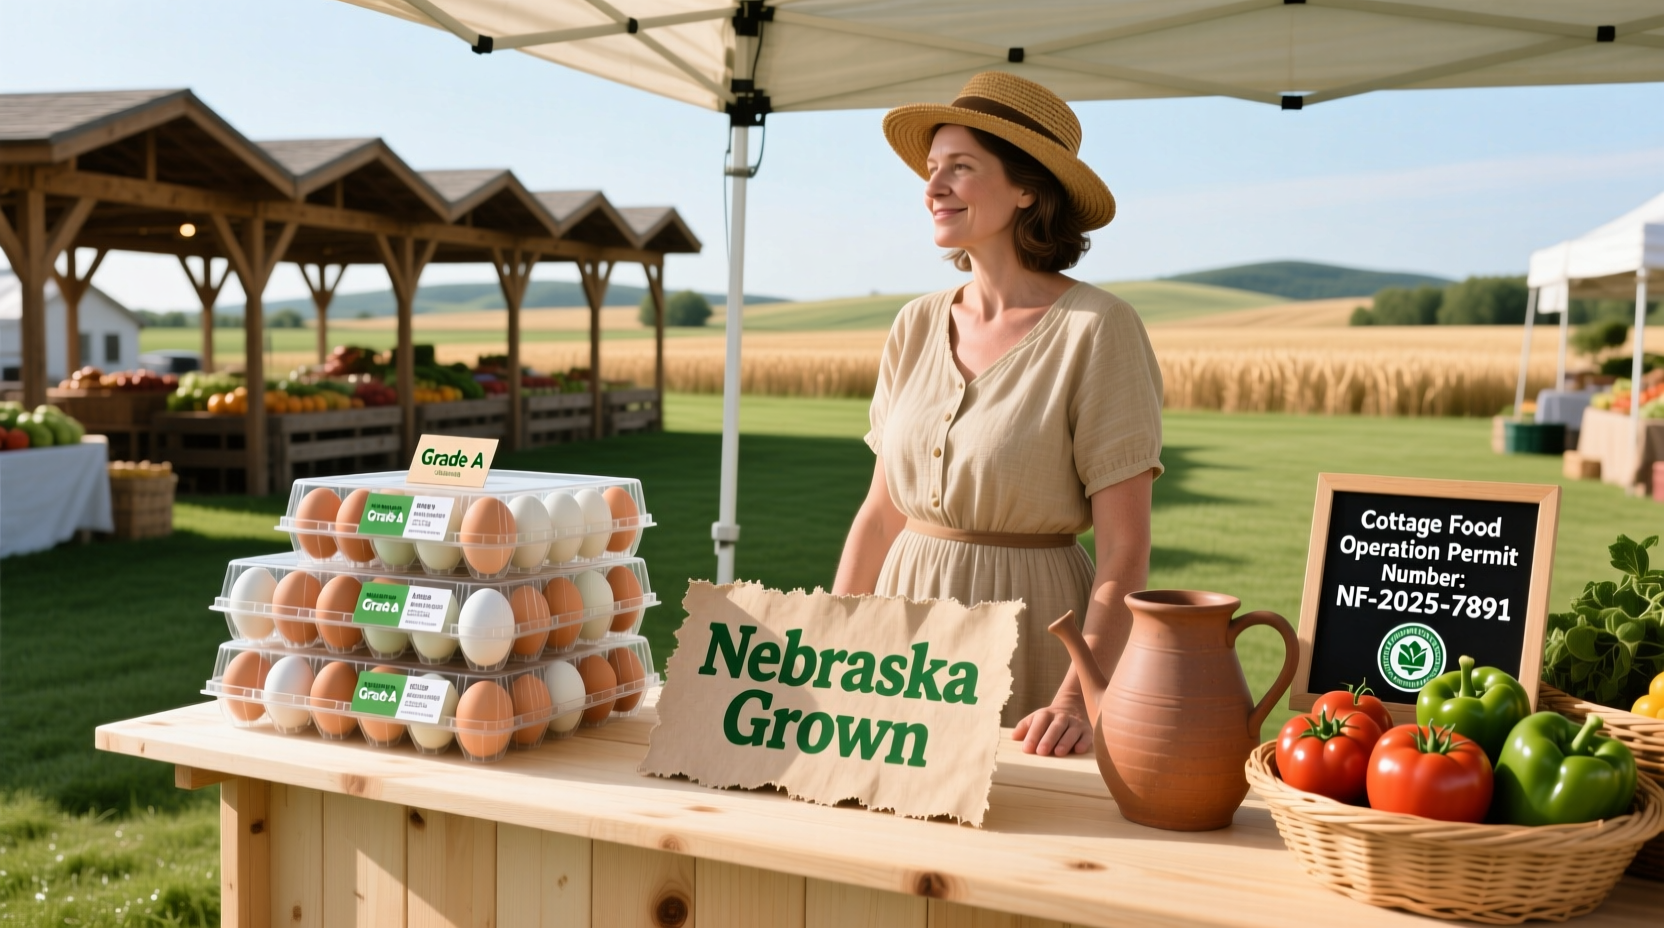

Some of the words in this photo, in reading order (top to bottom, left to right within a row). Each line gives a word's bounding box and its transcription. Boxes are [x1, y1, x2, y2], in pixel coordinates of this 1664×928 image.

[421, 448, 468, 468] Grade
[470, 452, 483, 469] A
[1361, 509, 1442, 538] Cottage
[1449, 514, 1502, 537] Food
[1340, 535, 1440, 560] Operation
[1447, 542, 1519, 566] Permit
[1381, 563, 1465, 588] Number:
[1336, 584, 1511, 621] NF-2025-7891
[698, 622, 979, 705] Nebraska
[723, 689, 929, 768] Grown
